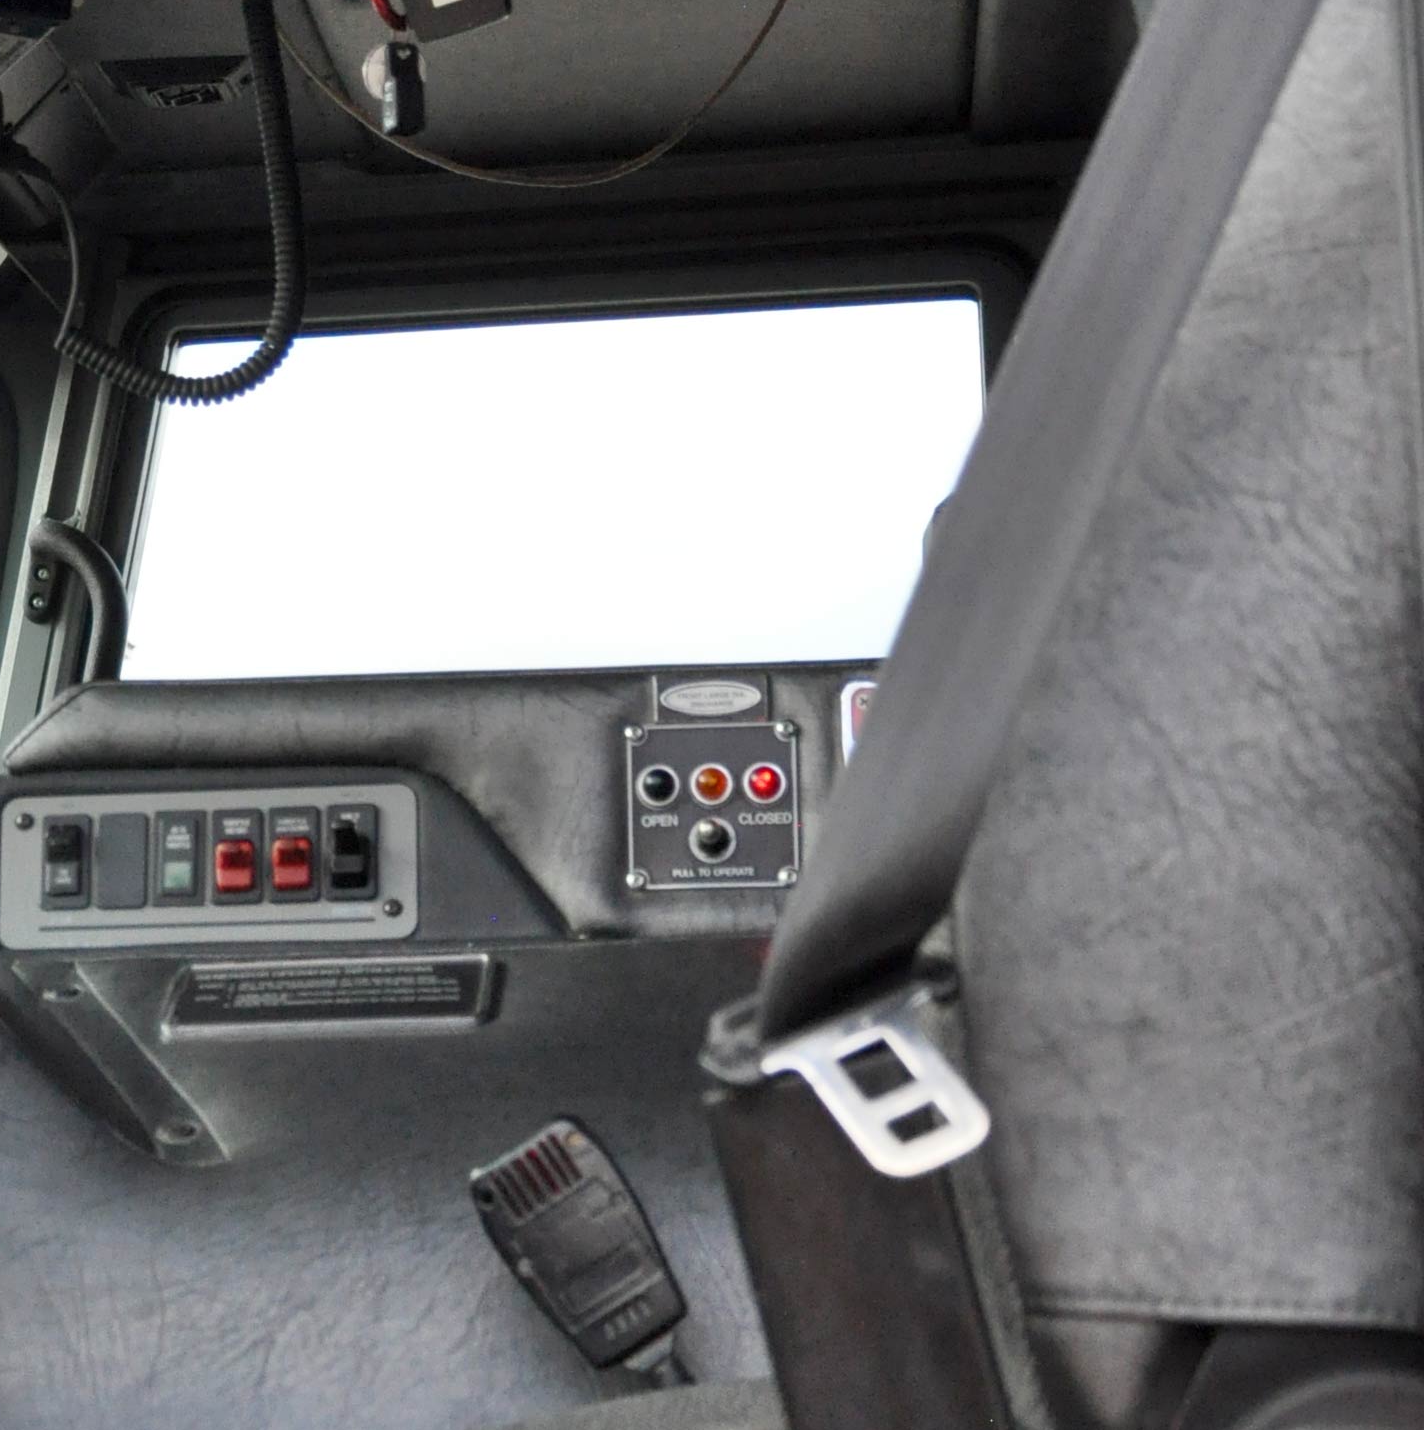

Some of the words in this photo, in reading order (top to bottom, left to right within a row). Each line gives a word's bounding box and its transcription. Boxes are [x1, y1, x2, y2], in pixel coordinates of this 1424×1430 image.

[641, 814, 679, 828] OPEN
[738, 813, 792, 826] CLOSED
[672, 869, 694, 878] PULL
[698, 868, 711, 877] TO
[713, 867, 755, 877] OPERATE
